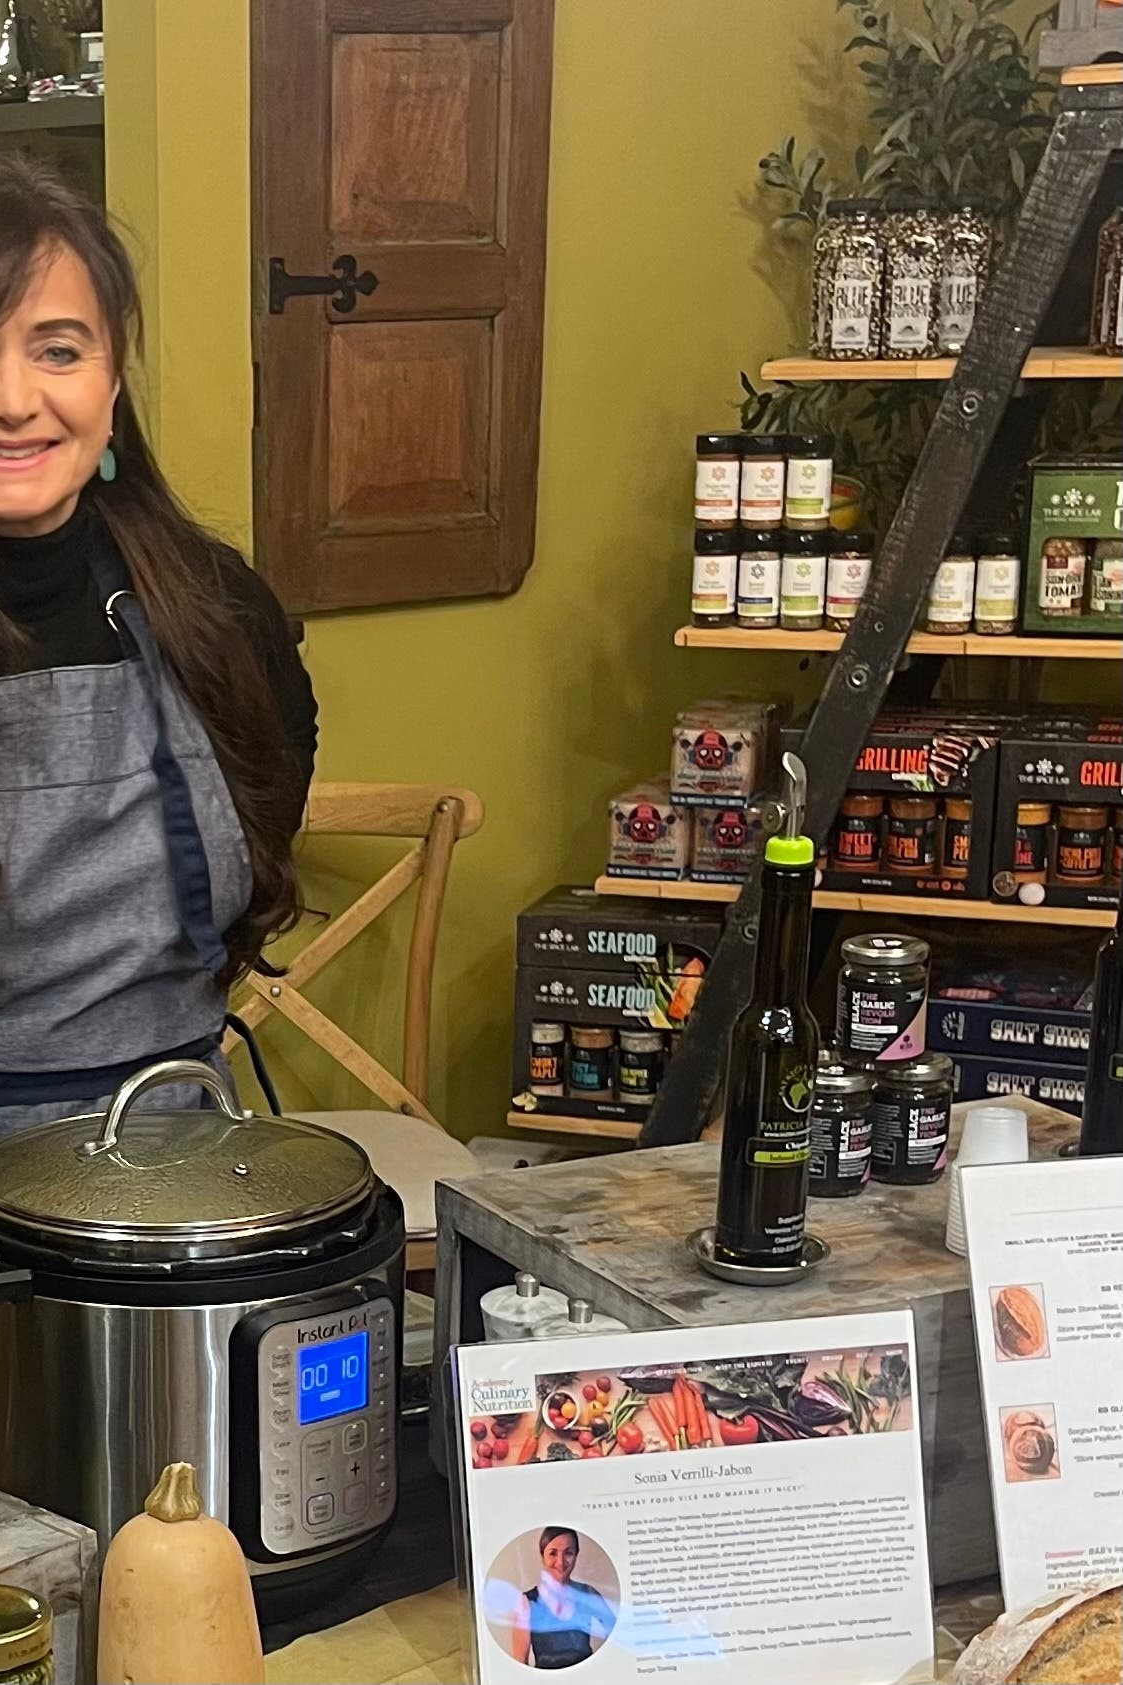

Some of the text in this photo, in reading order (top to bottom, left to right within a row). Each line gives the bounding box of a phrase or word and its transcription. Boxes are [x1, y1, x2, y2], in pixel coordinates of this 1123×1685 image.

[587, 930, 657, 955] SEAFOOD
[587, 983, 656, 1009] SEAFOOD
[851, 990, 861, 1023] BLACK
[860, 1001, 895, 1010] GARLIC
[990, 1018, 1040, 1045] SALT
[986, 1071, 1036, 1097] SALT
[297, 1319, 345, 1344] Instant
[471, 1386, 530, 1401] Culinary
[473, 1399, 534, 1413] Nutrition
[634, 1464, 753, 1485] Sonia Verrilli-Jabon
[650, 1496, 675, 1504] FOOD
